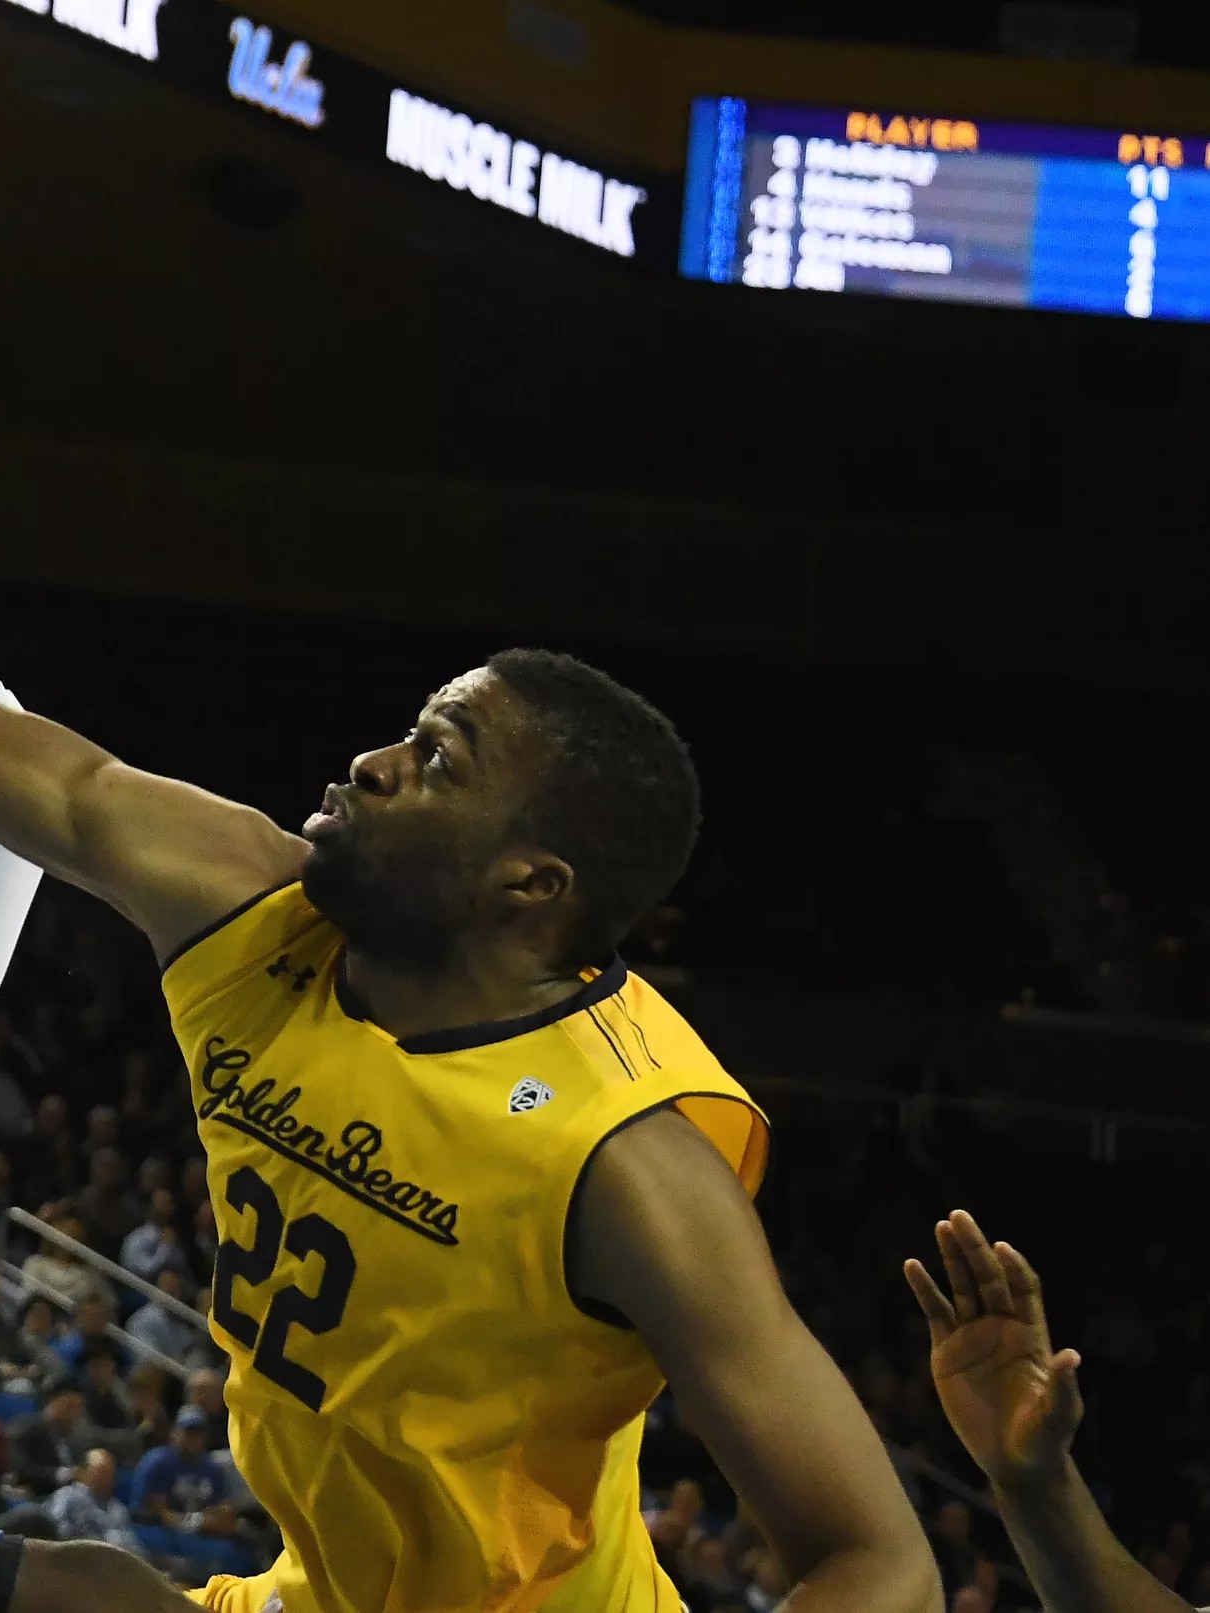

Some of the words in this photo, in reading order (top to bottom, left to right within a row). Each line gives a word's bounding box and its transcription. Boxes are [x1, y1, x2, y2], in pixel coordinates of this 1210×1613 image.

[387, 89, 540, 217] MUSCLE
[537, 153, 640, 257] MILK
[845, 110, 979, 152] PLAYER
[1117, 133, 1184, 169] PTS
[198, 1036, 326, 1158] Golden
[325, 1119, 460, 1236] Bears
[212, 1165, 357, 1414] 22
